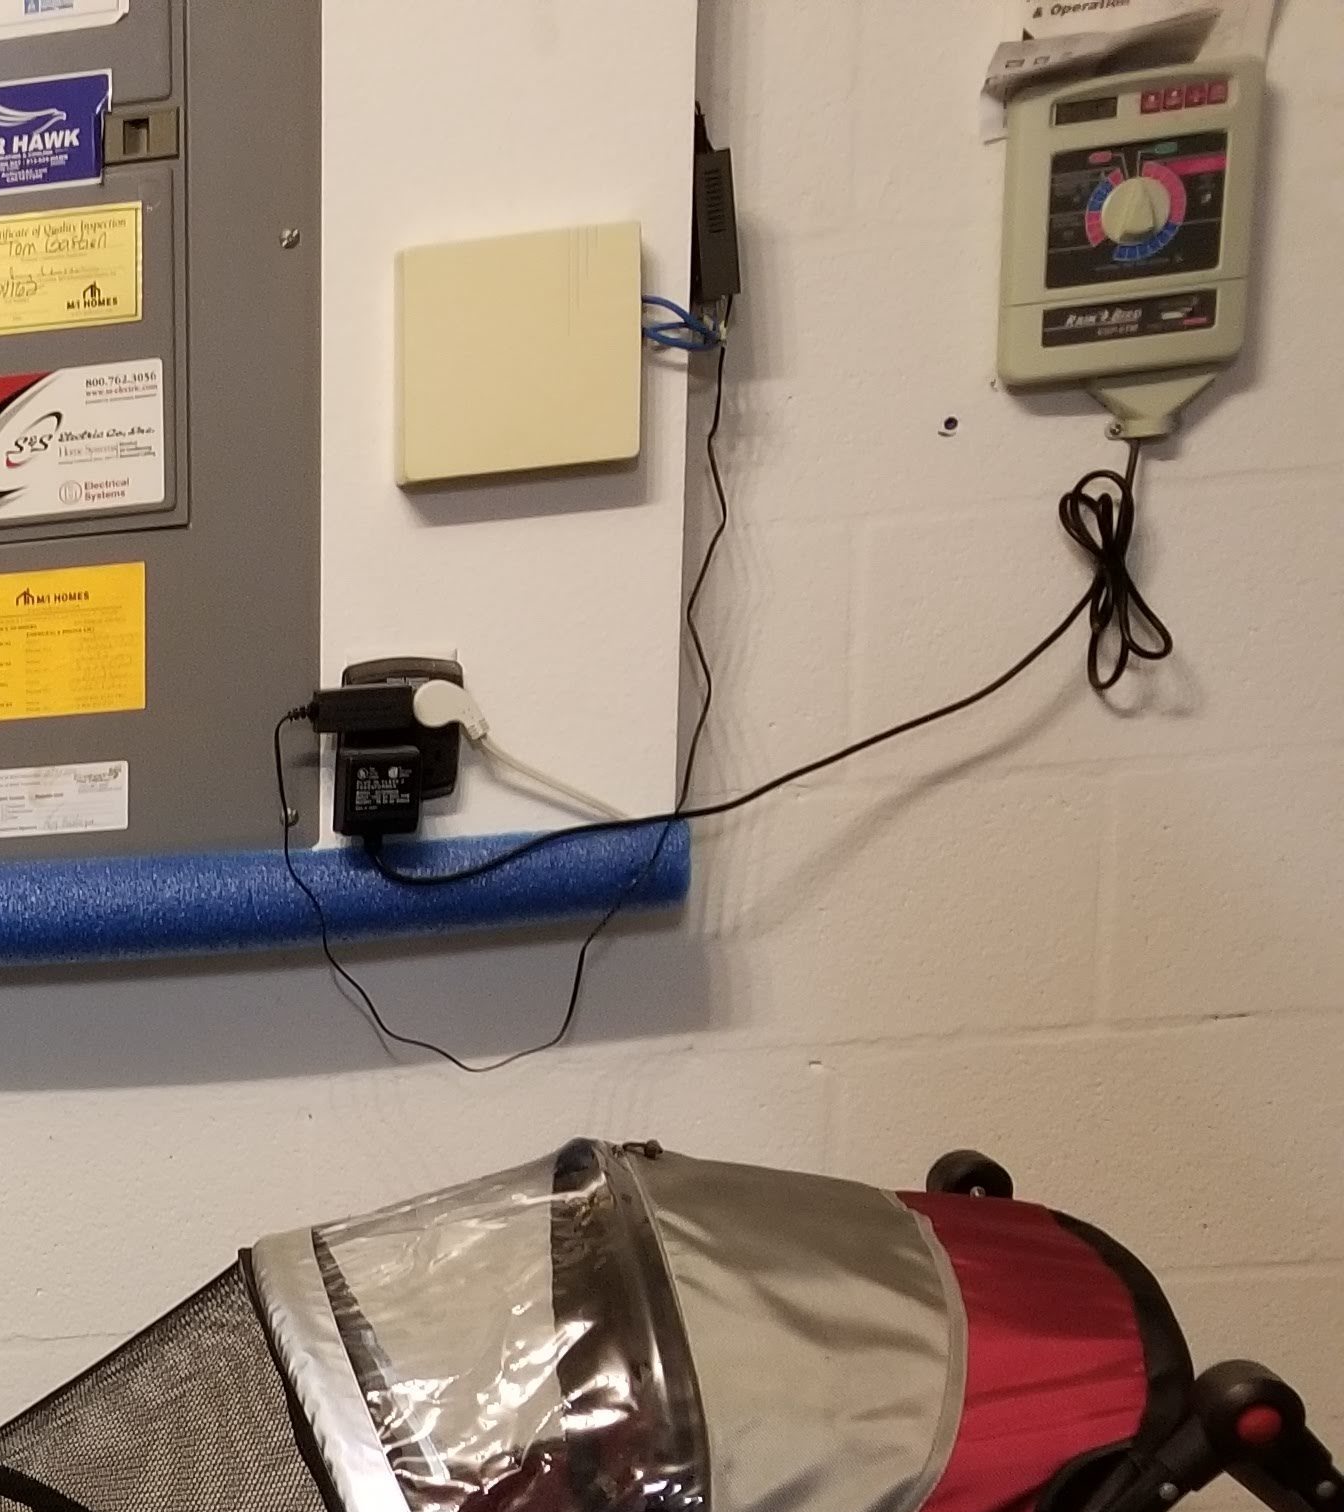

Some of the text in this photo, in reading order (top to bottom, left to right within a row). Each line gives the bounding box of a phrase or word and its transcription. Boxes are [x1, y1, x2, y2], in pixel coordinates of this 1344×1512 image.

[13, 128, 80, 154] HAWK
[32, 226, 41, 238] of
[84, 297, 118, 309] HOMES
[84, 478, 130, 491] Electrical
[84, 490, 126, 502] Systems
[54, 591, 89, 602] HOMES
